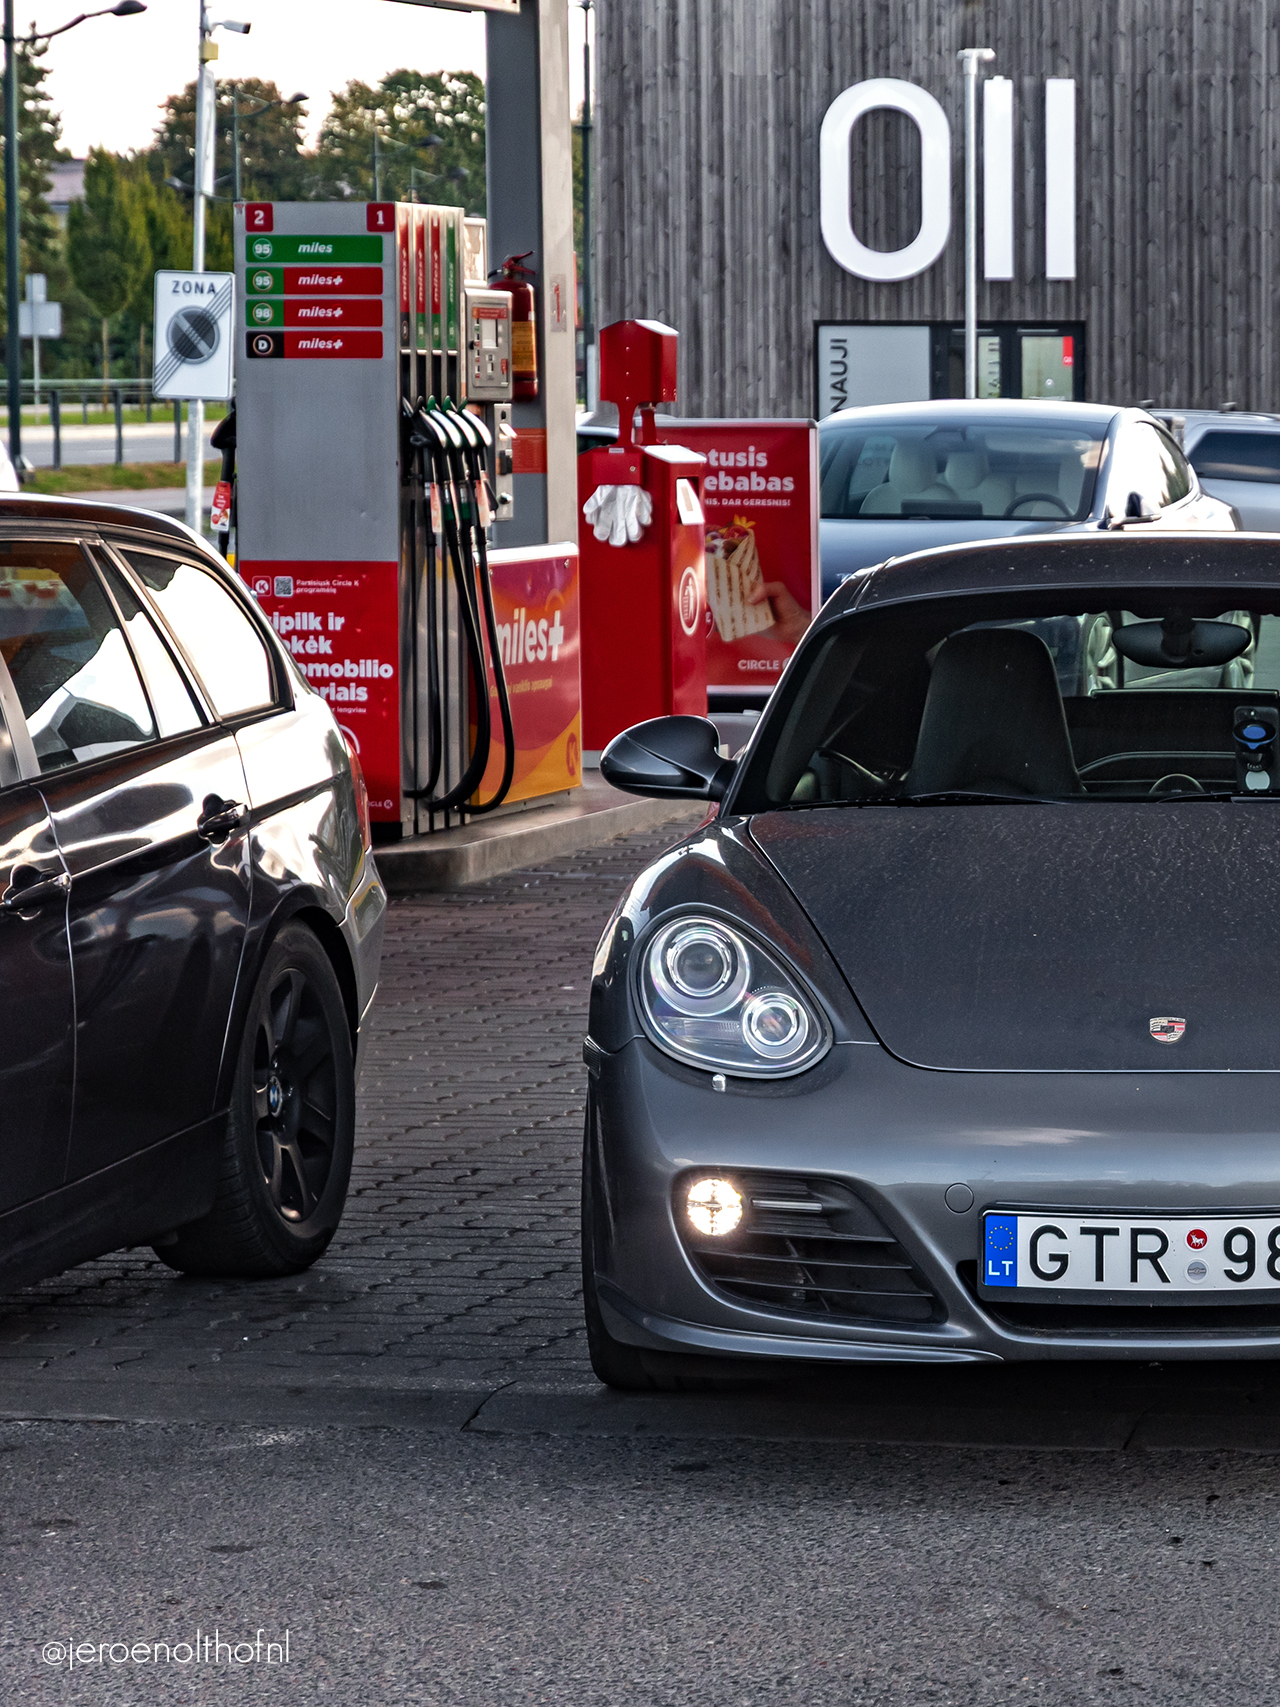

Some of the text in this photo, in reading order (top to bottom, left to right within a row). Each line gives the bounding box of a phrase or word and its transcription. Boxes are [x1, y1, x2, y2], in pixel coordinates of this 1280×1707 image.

[253, 210, 265, 226] 2
[375, 210, 385, 226] 1
[254, 242, 333, 255] 95 miles
[255, 274, 343, 286] 95 miles+
[171, 280, 218, 294] ZONA
[255, 306, 343, 318] 98 miles+
[258, 338, 343, 350] D miles+
[704, 470, 794, 491] ebabas
[722, 498, 741, 506] DAR
[268, 612, 345, 634] ipilk ir
[738, 659, 779, 671] CIRCLE
[988, 1260, 1014, 1276] LT
[1028, 1224, 1171, 1283] GTR
